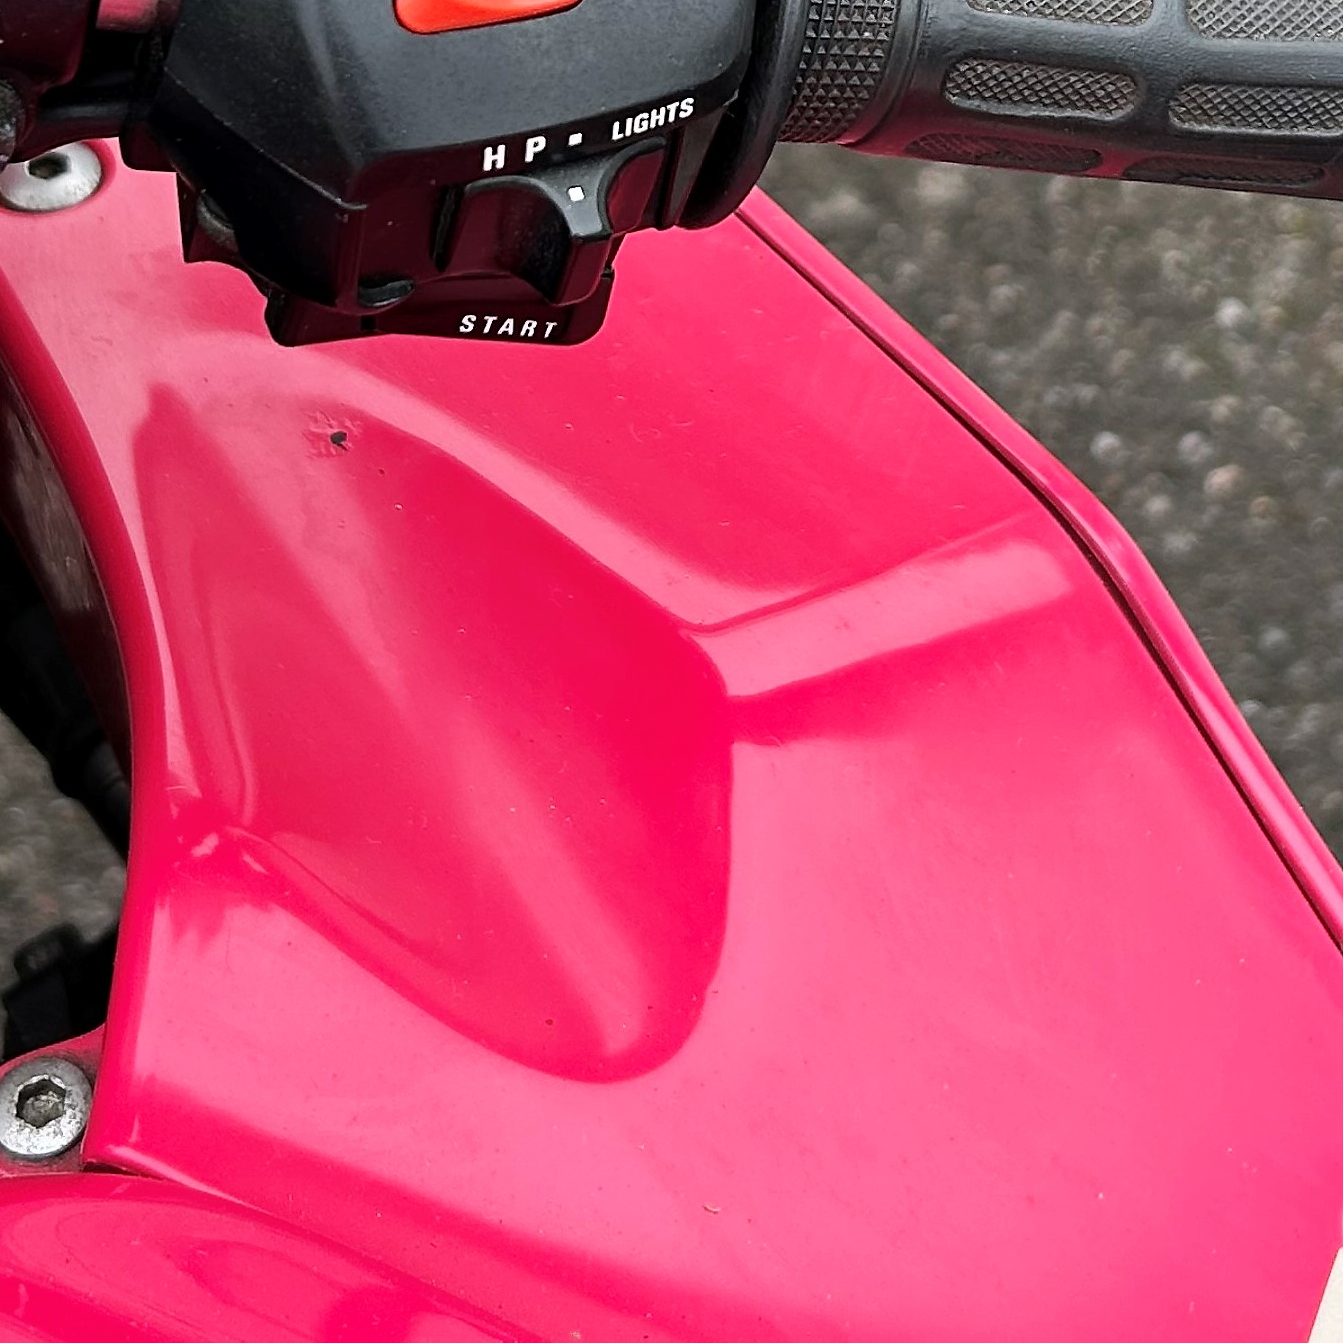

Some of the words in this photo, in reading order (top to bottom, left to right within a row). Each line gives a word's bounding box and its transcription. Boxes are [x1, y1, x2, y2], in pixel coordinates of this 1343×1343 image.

[482, 145, 506, 171] H
[524, 136, 546, 162] P
[611, 97, 695, 141] LIGHTS
[459, 314, 558, 339] START
